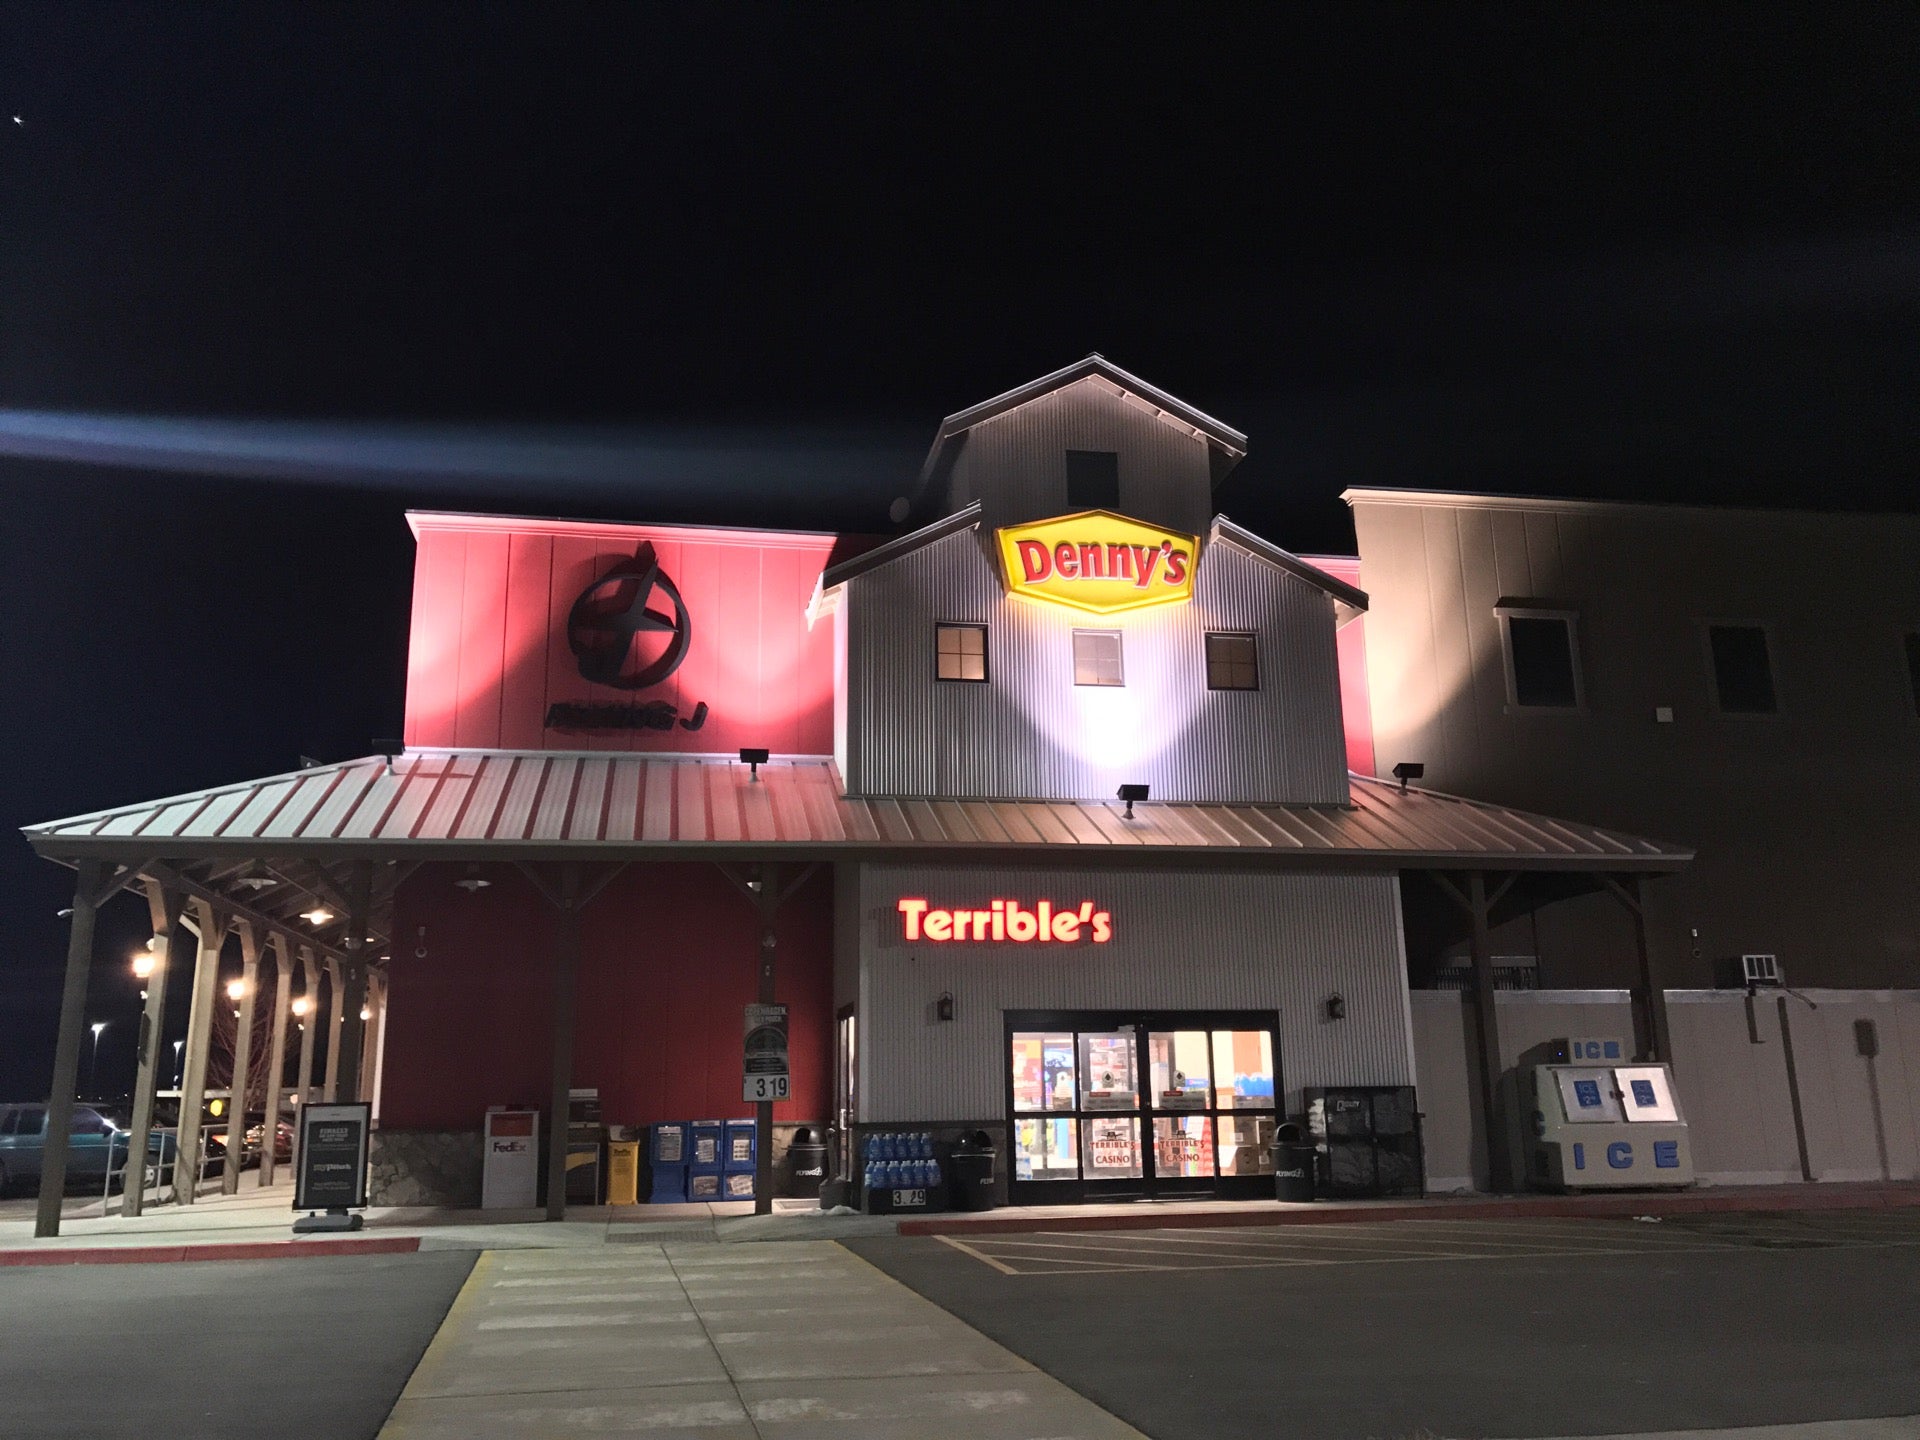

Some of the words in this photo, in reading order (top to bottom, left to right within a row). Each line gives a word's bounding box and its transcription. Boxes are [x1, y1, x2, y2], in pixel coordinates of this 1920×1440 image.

[1015, 539, 1188, 589] Denny's
[898, 898, 1112, 944] Terrible's
[493, 1142, 526, 1153] FedEx
[1089, 1140, 1135, 1150] TERRIBLE'S
[1159, 1140, 1205, 1149] TERRIBLE'S
[1095, 1155, 1130, 1164] CASINO
[1166, 1153, 1200, 1162] CASINO
[1573, 1140, 1680, 1170] ICE
